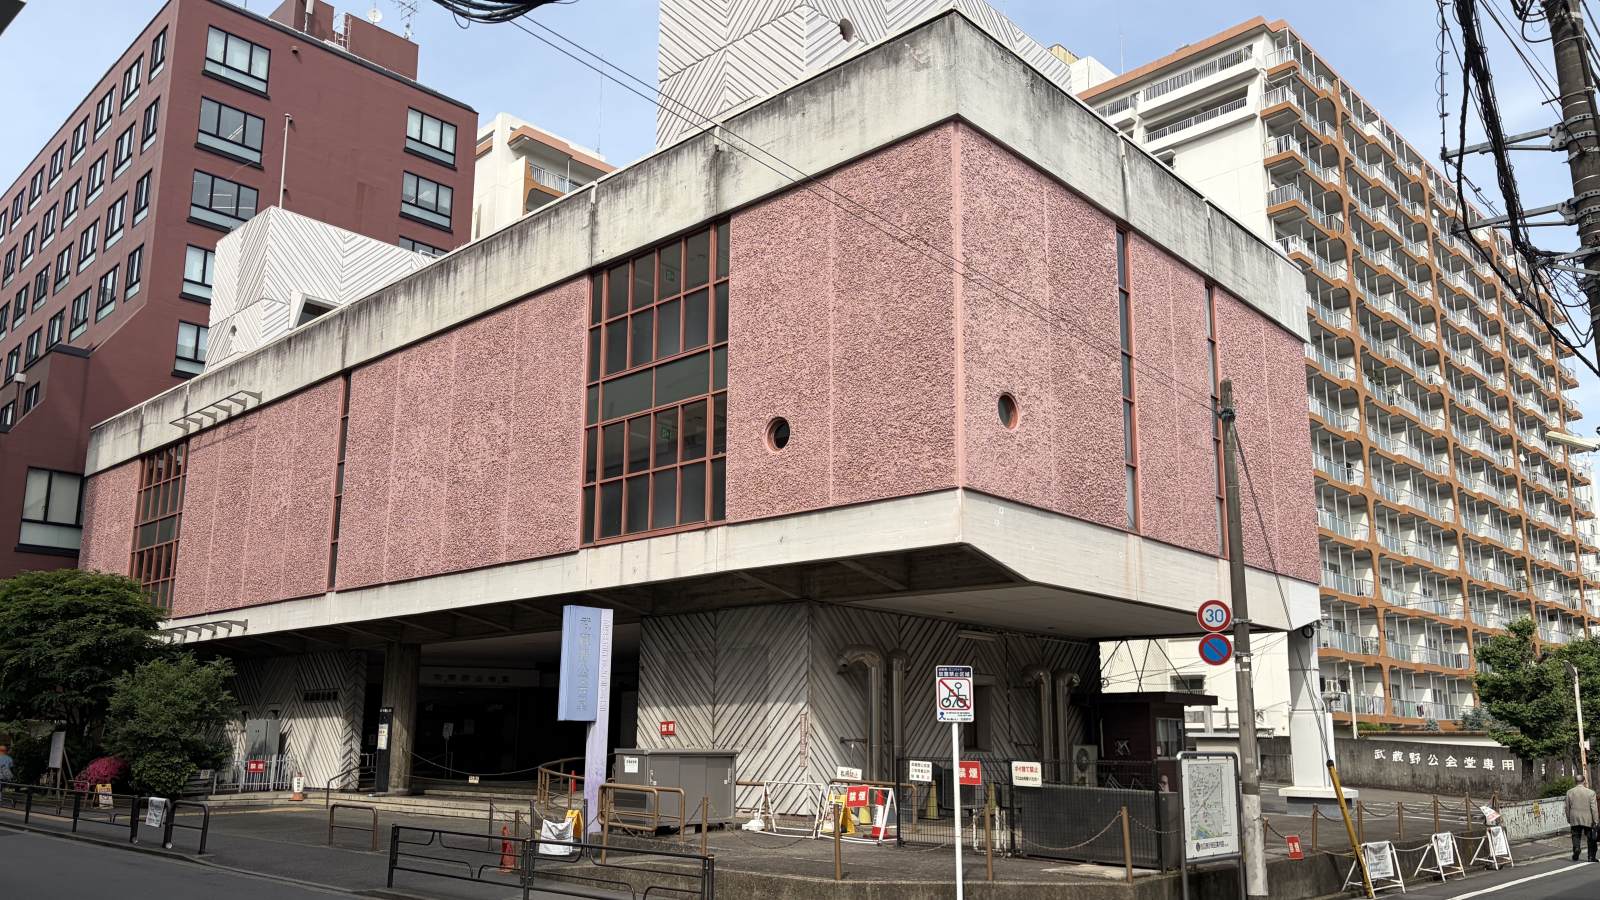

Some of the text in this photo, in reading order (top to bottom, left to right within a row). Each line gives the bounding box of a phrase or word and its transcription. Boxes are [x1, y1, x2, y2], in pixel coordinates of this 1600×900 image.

[1205, 608, 1224, 623] 30
[1373, 748, 1515, 771] 武蔵野公会堂専用
[849, 791, 866, 801] 禁煙
